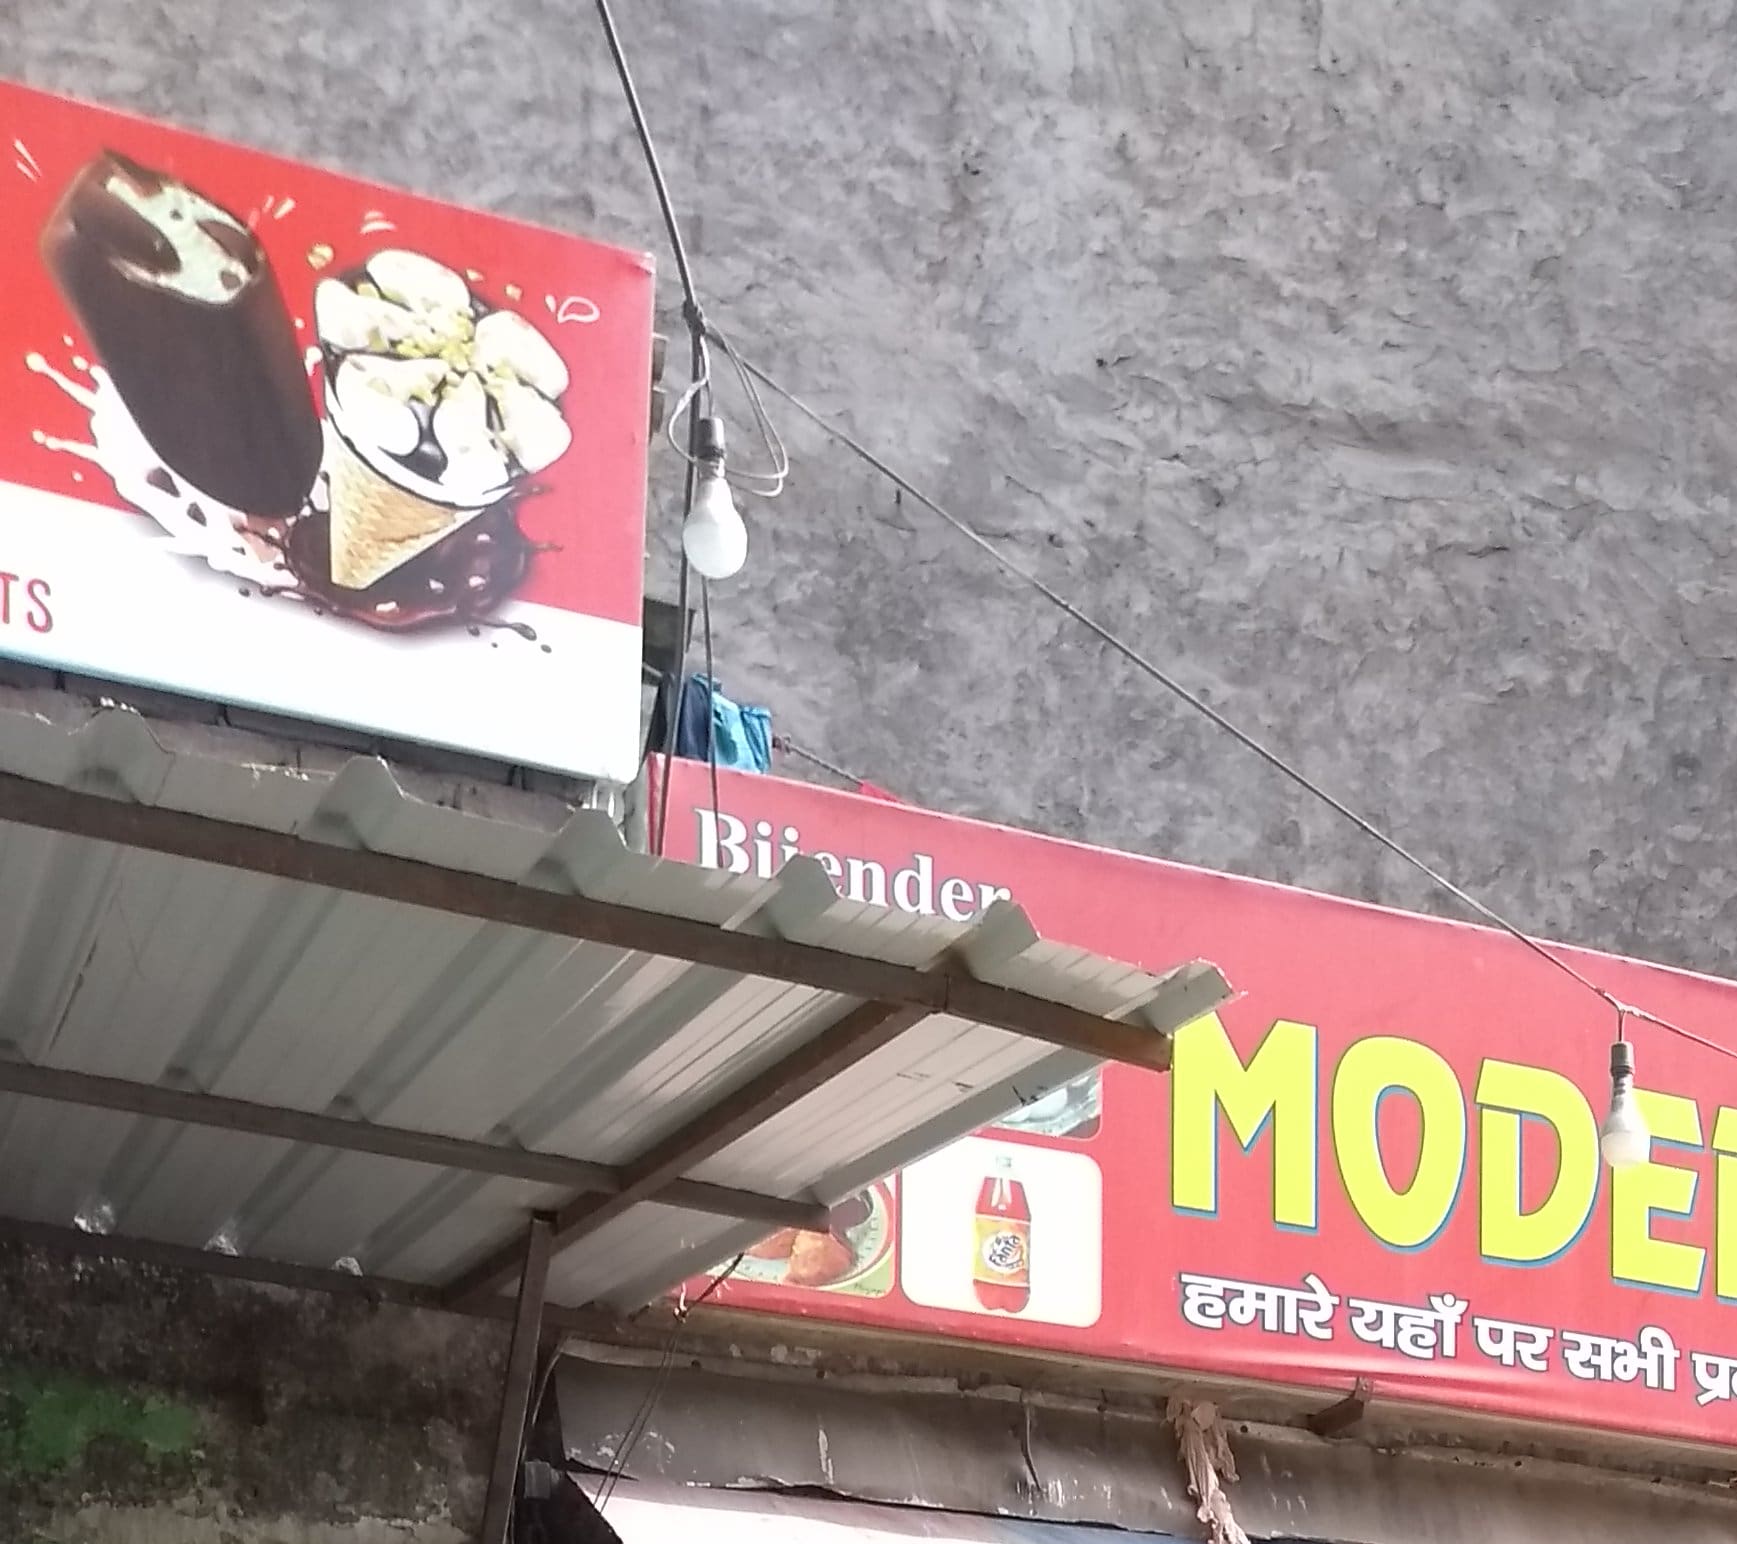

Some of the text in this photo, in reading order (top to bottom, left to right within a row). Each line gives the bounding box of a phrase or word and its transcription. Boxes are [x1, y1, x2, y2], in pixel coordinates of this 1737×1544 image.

[1179, 1273, 1341, 1342] हमारे
[1347, 1292, 1470, 1361] यहाँ
[1473, 1315, 1556, 1372] पर
[1561, 1325, 1681, 1393] सभी
